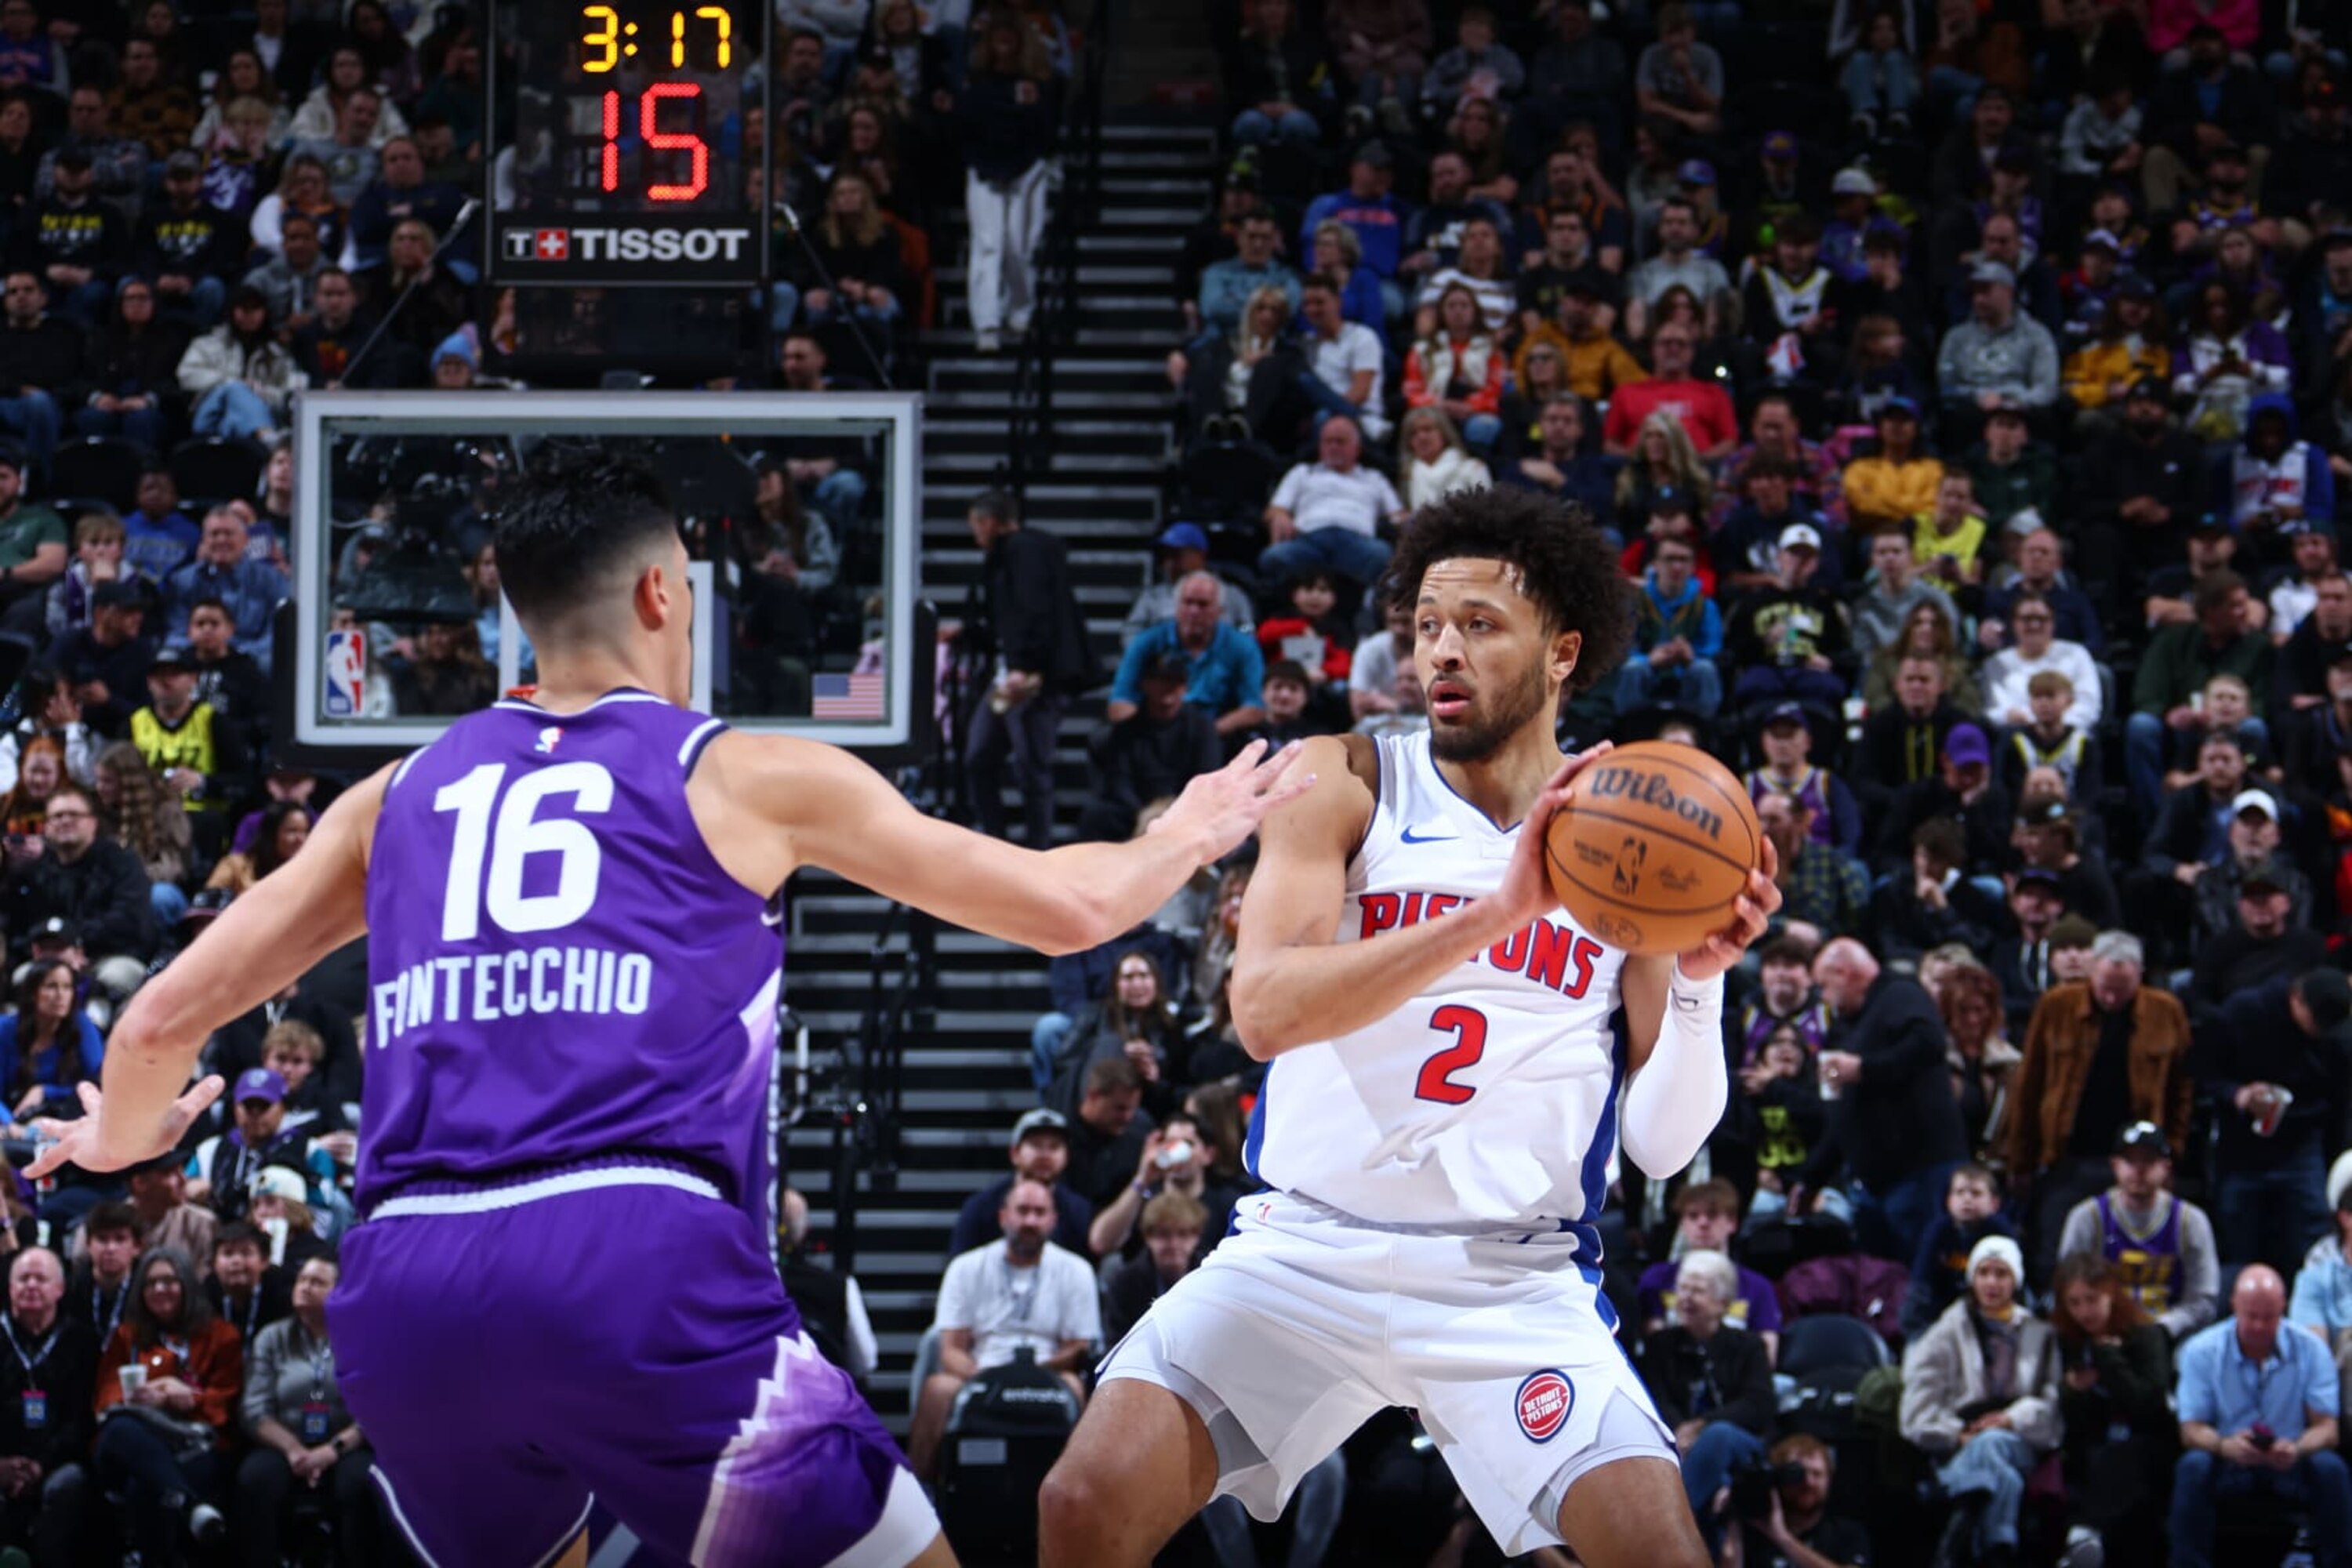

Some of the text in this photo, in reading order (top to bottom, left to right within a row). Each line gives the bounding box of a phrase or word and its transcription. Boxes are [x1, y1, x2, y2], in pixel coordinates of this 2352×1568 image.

[583, 5, 731, 72] 3:17
[602, 83, 709, 201] 15
[572, 228, 750, 260] TISSOT
[1591, 767, 1722, 841] Wilson
[434, 761, 614, 942] 16
[1359, 892, 1604, 1000] PIONS
[1414, 1004, 1488, 1106] 2
[1523, 1385, 1561, 1414] DETROIT
[1526, 1398, 1564, 1425] PISTONS
